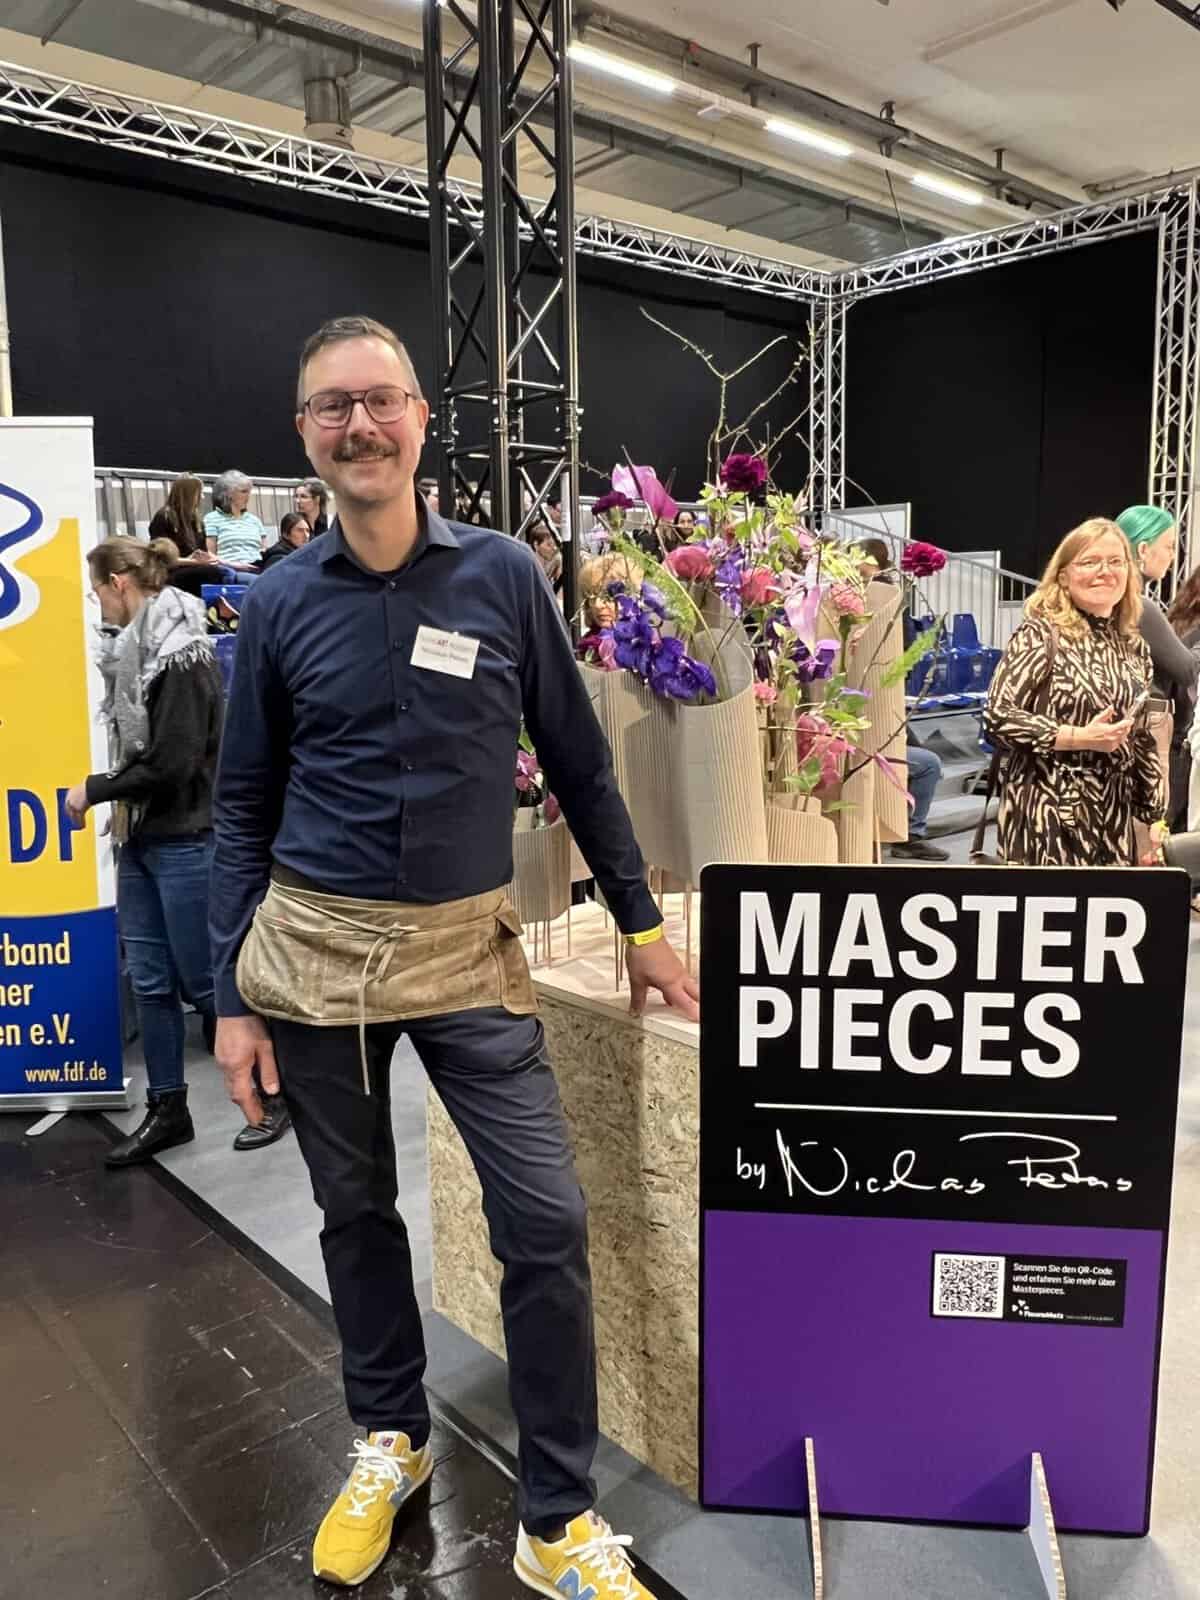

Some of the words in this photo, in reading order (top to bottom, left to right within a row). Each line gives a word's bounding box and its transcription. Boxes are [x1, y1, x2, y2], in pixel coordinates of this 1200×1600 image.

[0, 930, 71, 967] band
[739, 890, 1147, 984] MASTER
[29, 1013, 75, 1046] e.V.
[738, 985, 1082, 1079] PIECES
[25, 1060, 107, 1083] www.fdf.de
[736, 1147, 766, 1190] by
[1012, 1274, 1028, 1283] und
[1029, 1275, 1062, 1284] erfahren
[1063, 1276, 1076, 1285] Sie
[1076, 1277, 1097, 1286] mehr
[1098, 1278, 1116, 1287] über
[1013, 1263, 1047, 1273] Scannen
[1048, 1264, 1061, 1273] Sie
[1062, 1265, 1077, 1274] den
[1077, 1266, 1113, 1276] QR-Code
[1012, 1284, 1066, 1296] Masterpieces.
